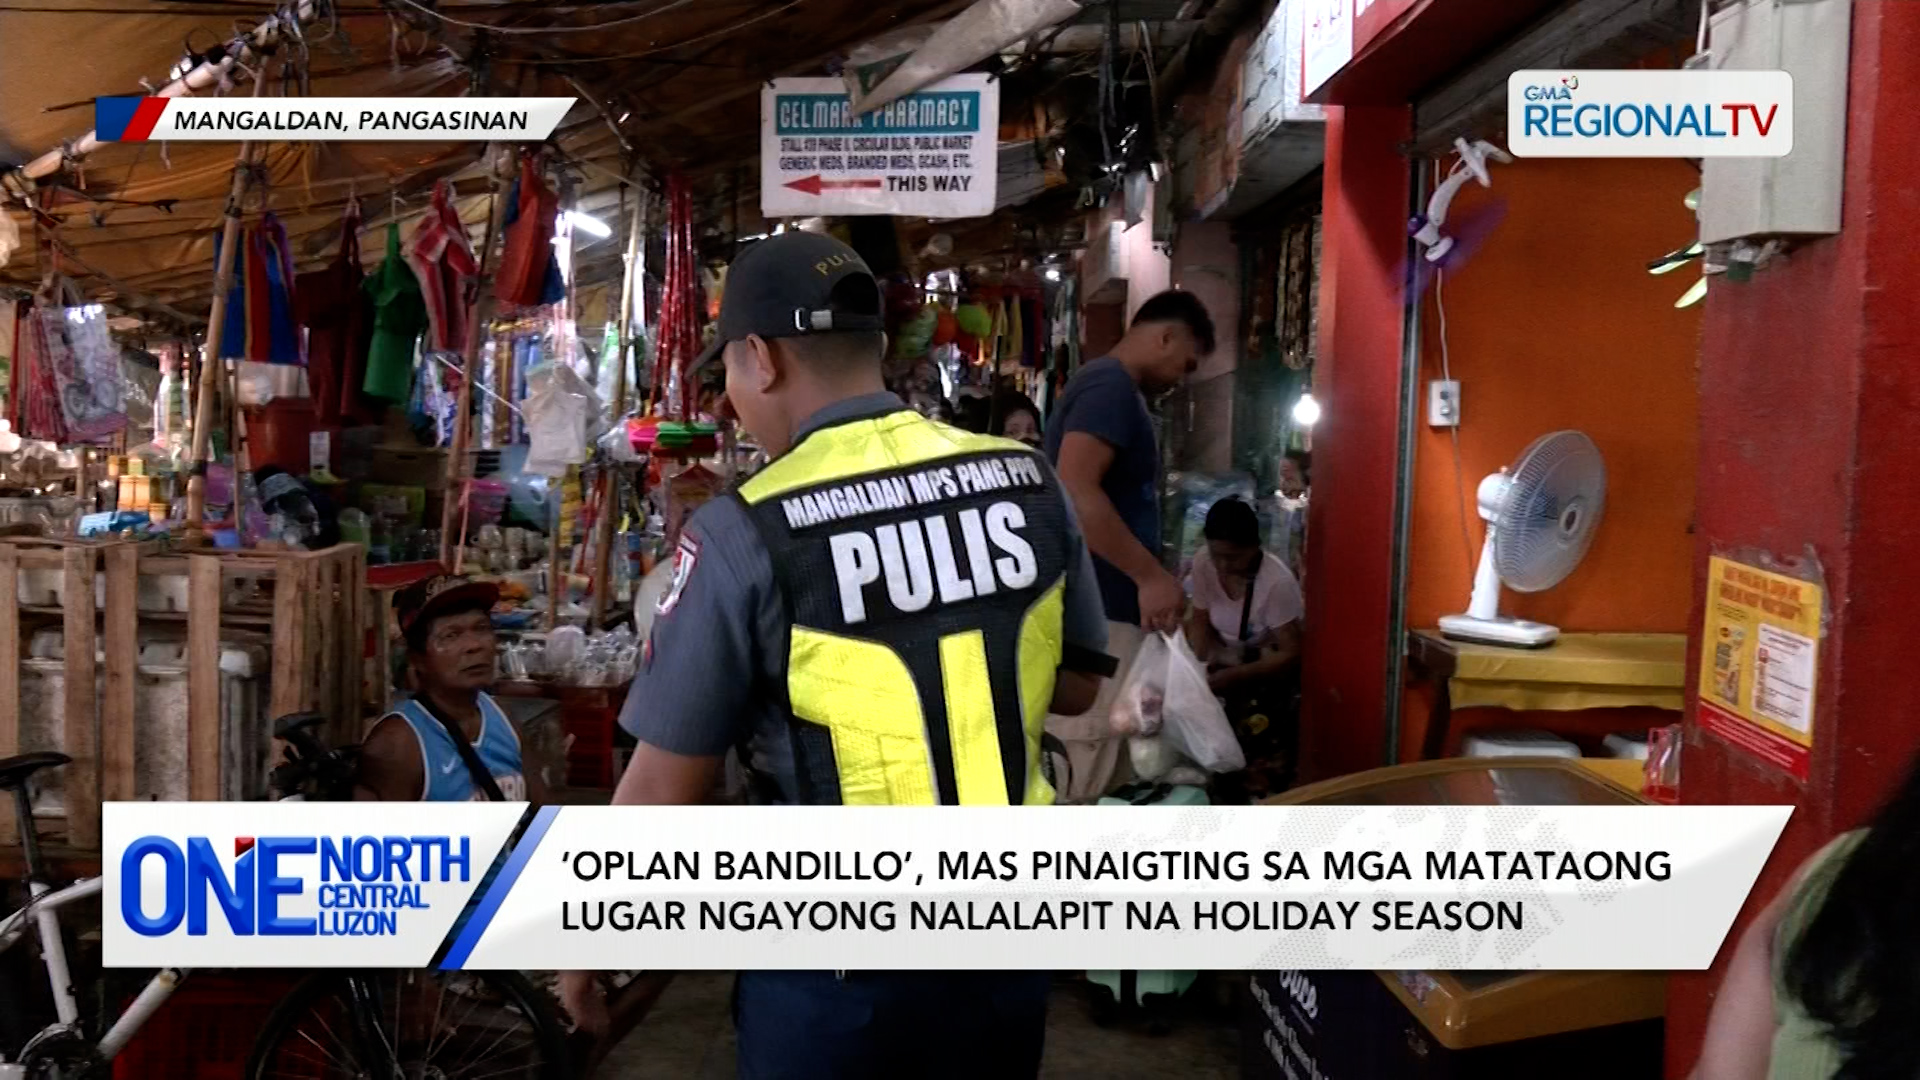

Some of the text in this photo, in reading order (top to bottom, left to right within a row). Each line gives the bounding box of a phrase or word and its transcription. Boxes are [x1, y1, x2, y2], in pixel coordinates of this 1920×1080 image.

[781, 137, 803, 152] STALL
[819, 137, 842, 152] PHASE
[853, 137, 889, 152] CIRCULAR
[914, 136, 940, 150] PUBLIC
[943, 135, 973, 150] MARKET
[779, 155, 817, 170] GENERIC
[819, 155, 844, 173] MEDS,
[847, 155, 887, 170] BRANDED
[886, 175, 972, 192] THIS WAY
[781, 456, 1043, 529] MANGALDAN MPS PANG PPO
[829, 501, 1038, 624] PULIS
